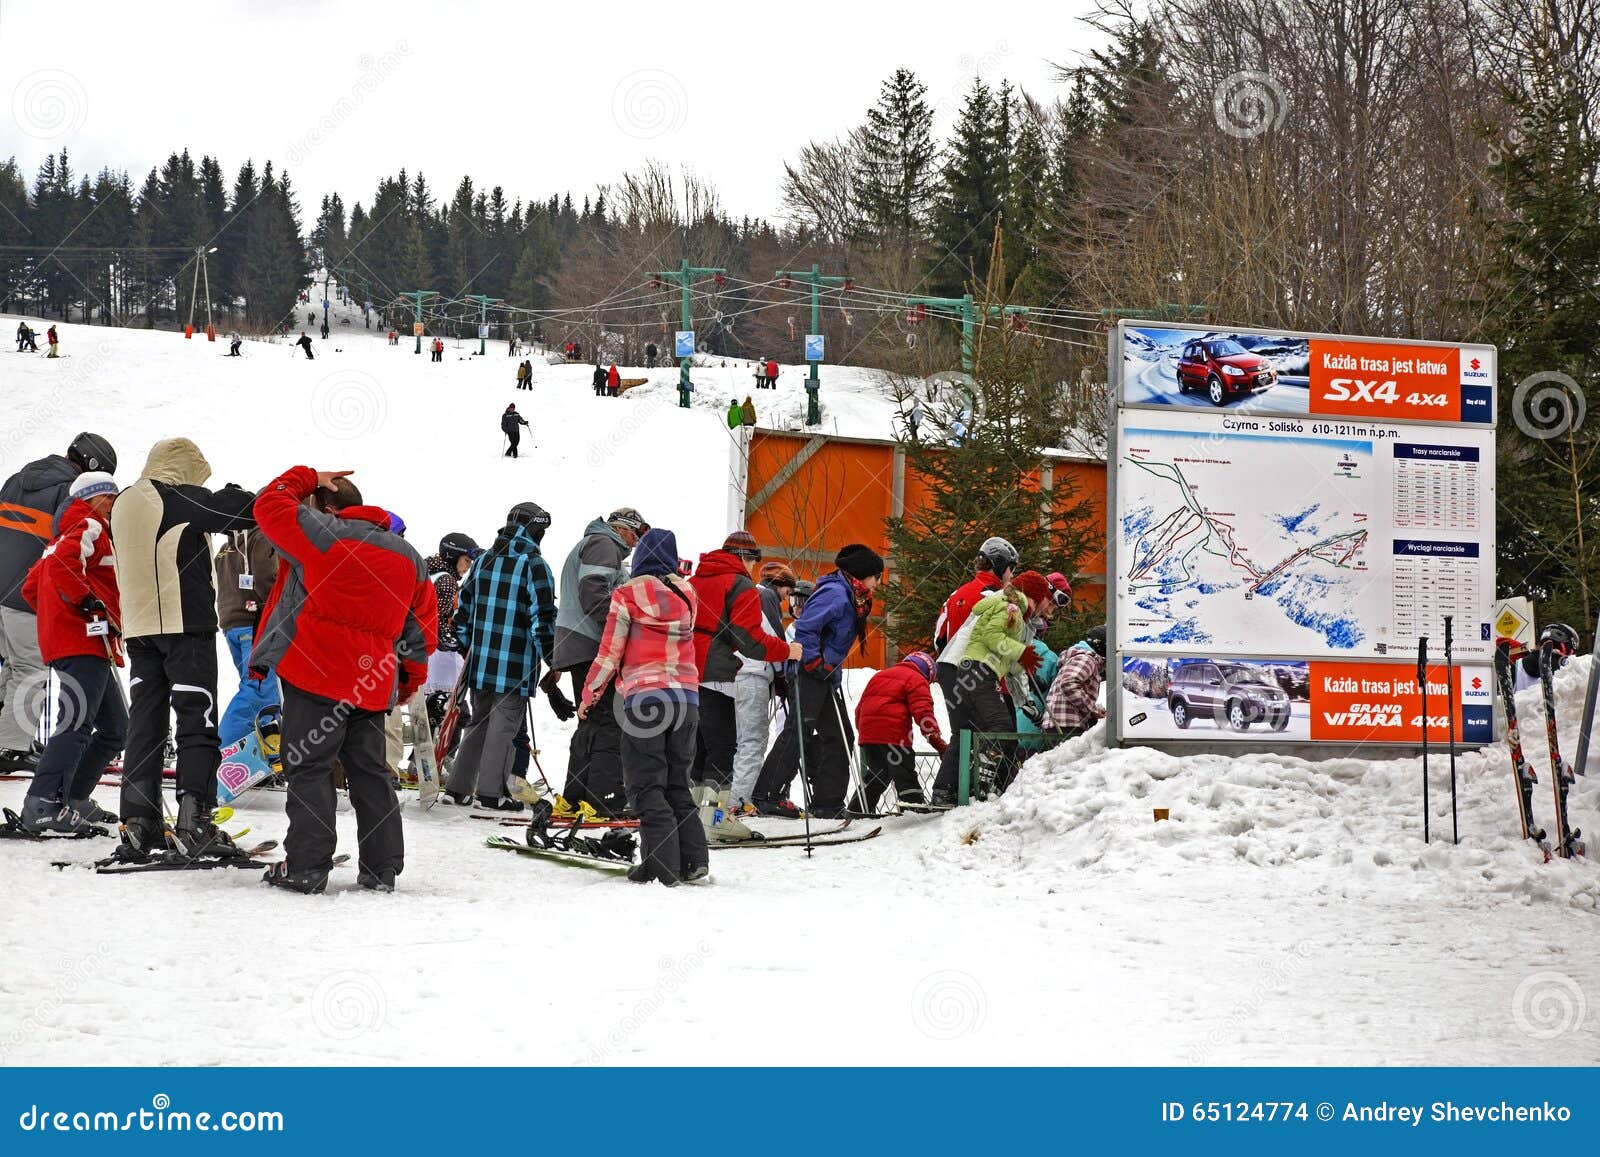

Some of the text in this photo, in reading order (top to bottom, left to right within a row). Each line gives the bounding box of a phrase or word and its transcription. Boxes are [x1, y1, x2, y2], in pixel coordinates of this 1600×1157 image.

[1323, 353, 1447, 376] Każda trasa jest łatwa
[1323, 378, 1400, 404] SX4
[1223, 419, 1258, 431] Czyrna
[1269, 422, 1304, 433] Solisko
[1312, 424, 1367, 436] 610-1211m
[1324, 676, 1358, 693] Każda
[1361, 678, 1390, 694] trasa
[1392, 678, 1414, 697] jest
[1349, 703, 1402, 714] GRAND
[1323, 712, 1403, 727] VITARA
